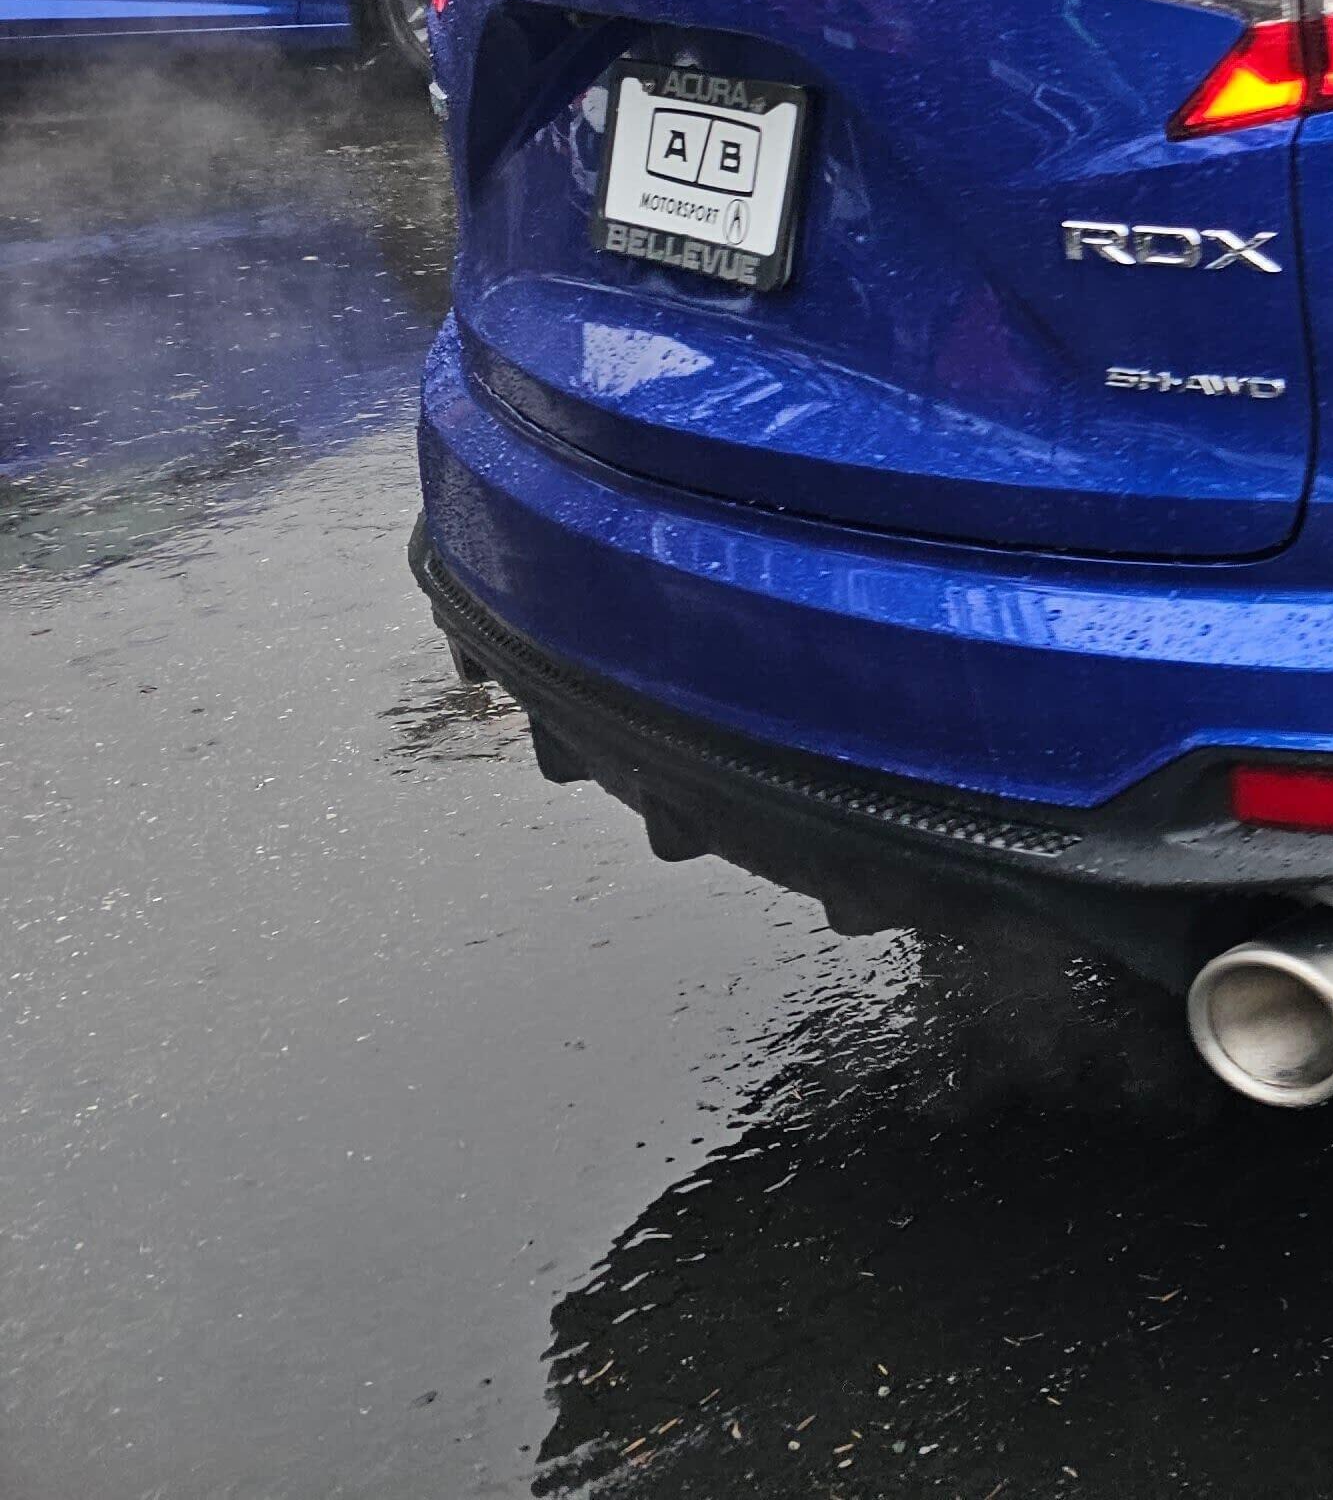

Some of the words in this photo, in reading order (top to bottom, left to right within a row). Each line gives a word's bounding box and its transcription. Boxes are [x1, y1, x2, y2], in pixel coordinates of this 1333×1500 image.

[664, 70, 750, 109] ACURA
[663, 129, 688, 162] A
[719, 140, 742, 174] B
[638, 192, 721, 225] MOTORSPORT
[606, 223, 761, 285] BELLEVUE
[1061, 219, 1282, 273] RDX
[1104, 366, 1287, 399] SH-AWD
